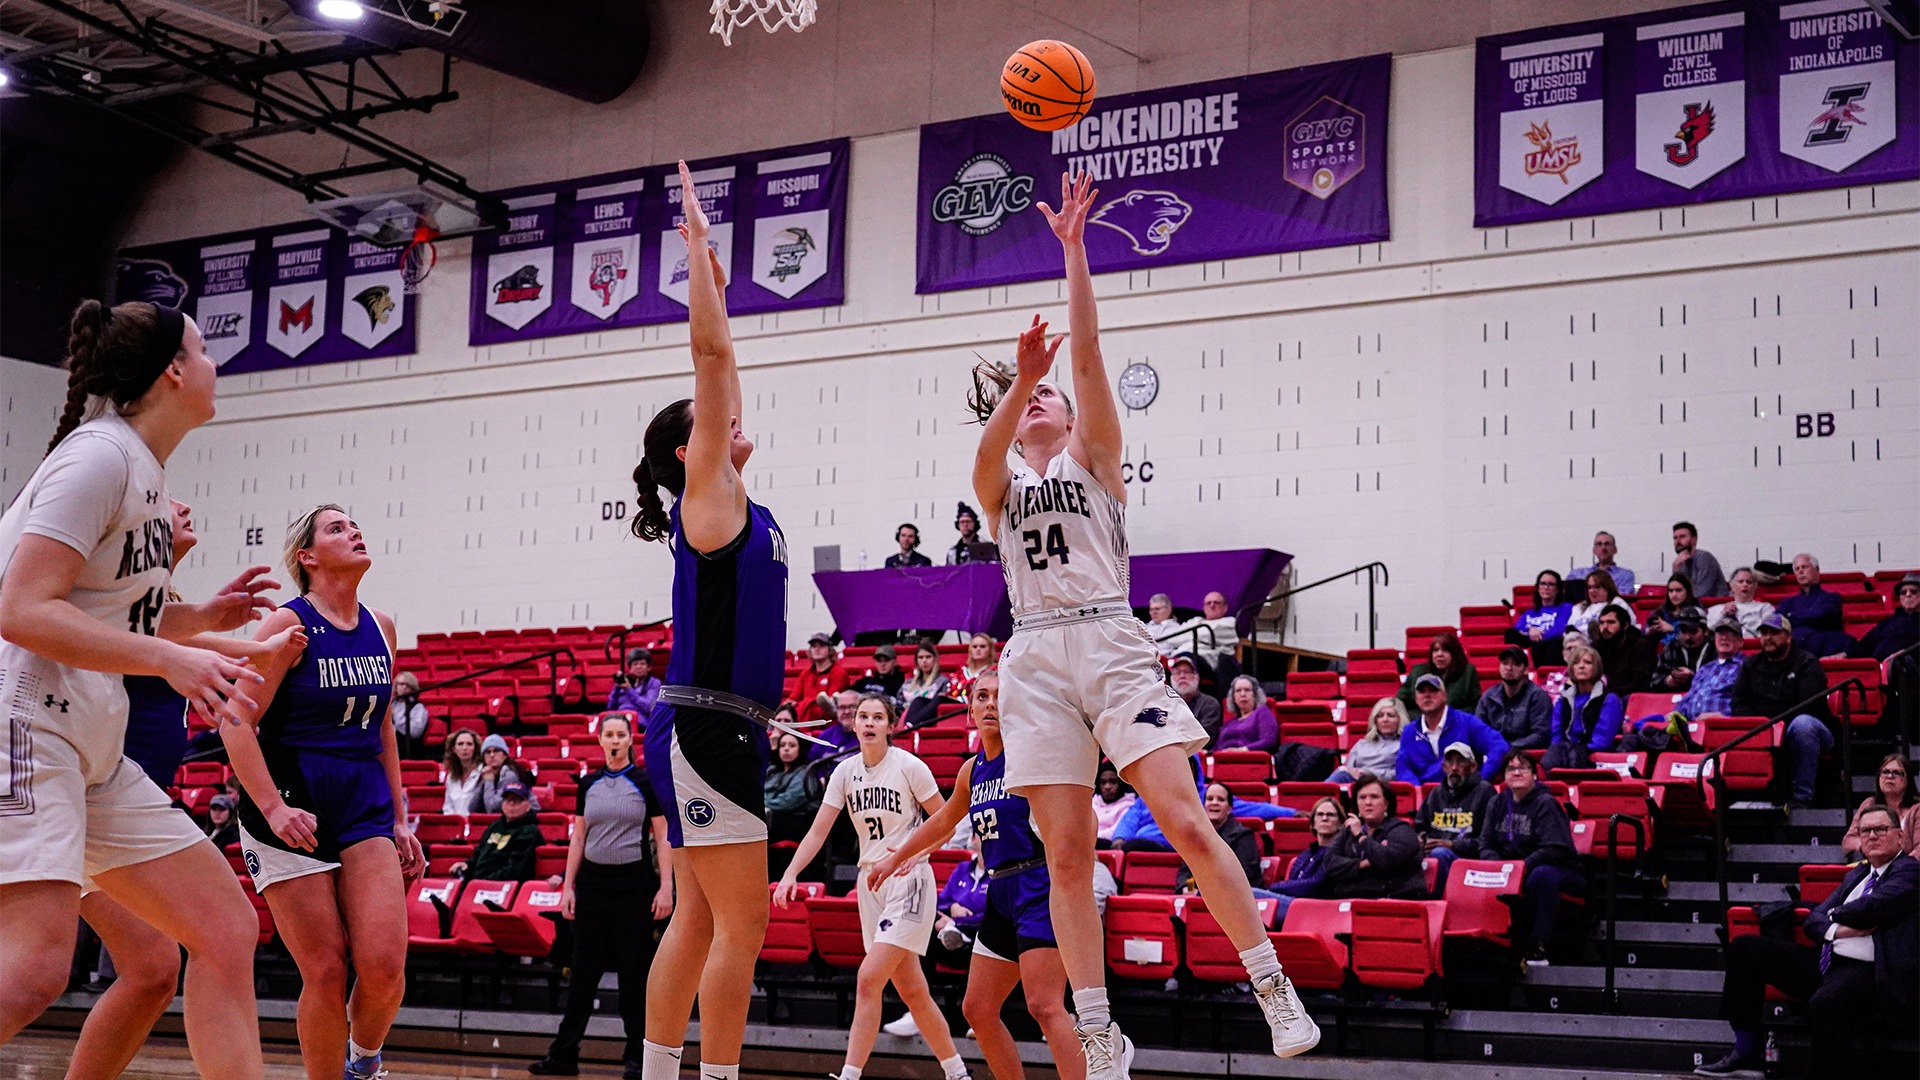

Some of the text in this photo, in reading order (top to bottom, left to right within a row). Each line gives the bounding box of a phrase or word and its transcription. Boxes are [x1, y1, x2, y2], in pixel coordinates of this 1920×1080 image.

[1789, 11, 1882, 40] UNIVERSITY
[1658, 32, 1723, 58] WILLIAM
[1827, 35, 1844, 50] OF
[1509, 51, 1594, 79] UNIVERSITY
[1668, 53, 1712, 72] JEWEL
[1789, 45, 1883, 71] INDIANAPOLIS
[1514, 71, 1587, 93] OF MISSOURI
[1663, 67, 1717, 88] COLLEGE
[1523, 87, 1578, 107] ST. LOUIS
[1291, 116, 1355, 144] GLVC
[1292, 141, 1356, 159] SPORTS
[1526, 144, 1581, 171] UMSL
[1068, 137, 1224, 185] UNIVERSITY
[1292, 154, 1355, 170] NETWORK
[668, 181, 730, 204] SOHWEST
[767, 174, 820, 196] MISSOURI
[783, 194, 801, 207] S&T
[932, 175, 1034, 222] GLVC
[594, 202, 625, 219] LEWIS
[585, 217, 633, 234] UNIVERSITY
[499, 229, 545, 246] UNIVERSITY
[204, 254, 250, 273] UNIVERSITY
[278, 247, 322, 267] MARYVILLE
[354, 253, 397, 269] UNIVERSITY
[278, 263, 319, 279] UNIVERSITY
[1796, 412, 1836, 438] BB
[1121, 461, 1154, 484] CC
[603, 502, 625, 520] DD
[246, 528, 263, 546] EE
[1022, 523, 1070, 571] 24
[318, 655, 391, 688] ROCKHURST
[337, 695, 378, 729] 11
[864, 817, 885, 840] 21
[973, 808, 1000, 841] 22
[1628, 954, 1636, 964] D
[1550, 998, 1558, 1008] C
[493, 1037, 499, 1049] A
[1483, 1043, 1493, 1056] B
[1693, 1053, 1703, 1066] B
